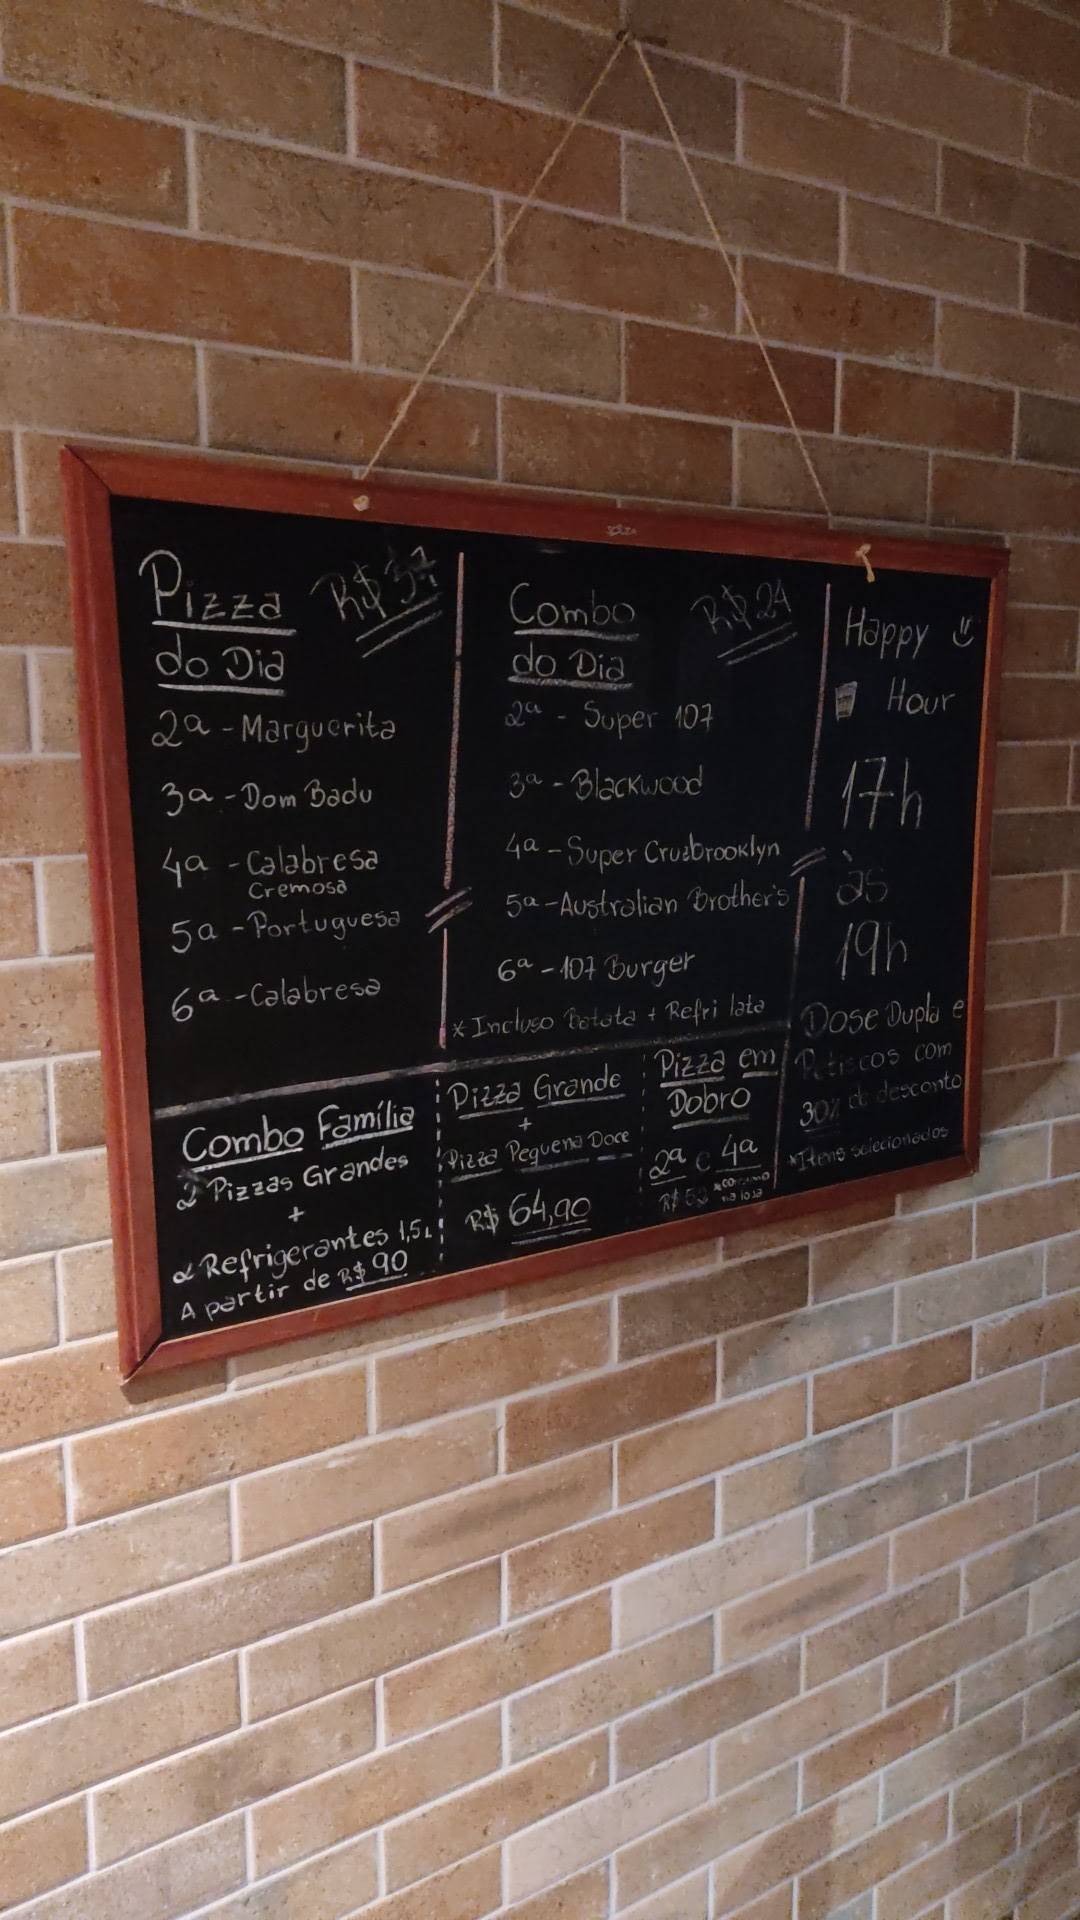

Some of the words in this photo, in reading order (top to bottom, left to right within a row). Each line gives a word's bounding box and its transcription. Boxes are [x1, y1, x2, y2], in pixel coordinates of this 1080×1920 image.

[138, 549, 282, 620] Pizza
[509, 582, 635, 627] Combo
[845, 605, 930, 660] Happy
[154, 632, 209, 679] do
[221, 646, 284, 681] Dia
[512, 640, 557, 678] do
[568, 647, 626, 681] Dia
[887, 676, 956, 715] Hour
[242, 711, 397, 753] Marguerita
[583, 700, 658, 740] Super
[674, 703, 714, 731] 107
[240, 782, 297, 810] Dom
[304, 777, 373, 808] Badu
[841, 756, 923, 830] 17h
[246, 843, 379, 876] Calabresa
[567, 835, 637, 874] Super
[248, 879, 348, 899] Cremosa
[560, 888, 678, 919] Australian
[687, 879, 790, 912] Brother's
[246, 908, 401, 941] Portuguesa
[559, 955, 597, 981] 107
[604, 951, 695, 988] Burger
[835, 920, 907, 981] 19h
[250, 976, 382, 1007] Calabresa
[564, 1004, 636, 1031] Batata
[665, 998, 718, 1026] Refri
[800, 1001, 879, 1039] Dose
[885, 990, 940, 1033] Dupla
[952, 999, 965, 1019] e
[653, 1048, 726, 1079] Pizza
[738, 1047, 776, 1069] em
[794, 1047, 900, 1080] Pticos
[914, 1041, 952, 1063] com
[446, 1081, 521, 1111] Pizza
[533, 1062, 621, 1101] Grande
[666, 1082, 752, 1118] Dobro
[182, 1114, 305, 1162] Combo
[317, 1100, 415, 1141] Família
[443, 1147, 499, 1170] Pizza
[505, 1134, 583, 1168] Pequena
[586, 1129, 631, 1149] Doce
[206, 1174, 293, 1203] Pizzas
[302, 1145, 409, 1188] Grandes
[465, 1203, 500, 1235] R$
[508, 1188, 592, 1227] 64,90
[199, 1224, 389, 1283] Refrigerantes
[180, 1301, 196, 1321] A
[204, 1281, 291, 1321] partir
[303, 1267, 331, 1292] de
[337, 1260, 366, 1287] R$
[371, 1249, 408, 1276] 90
